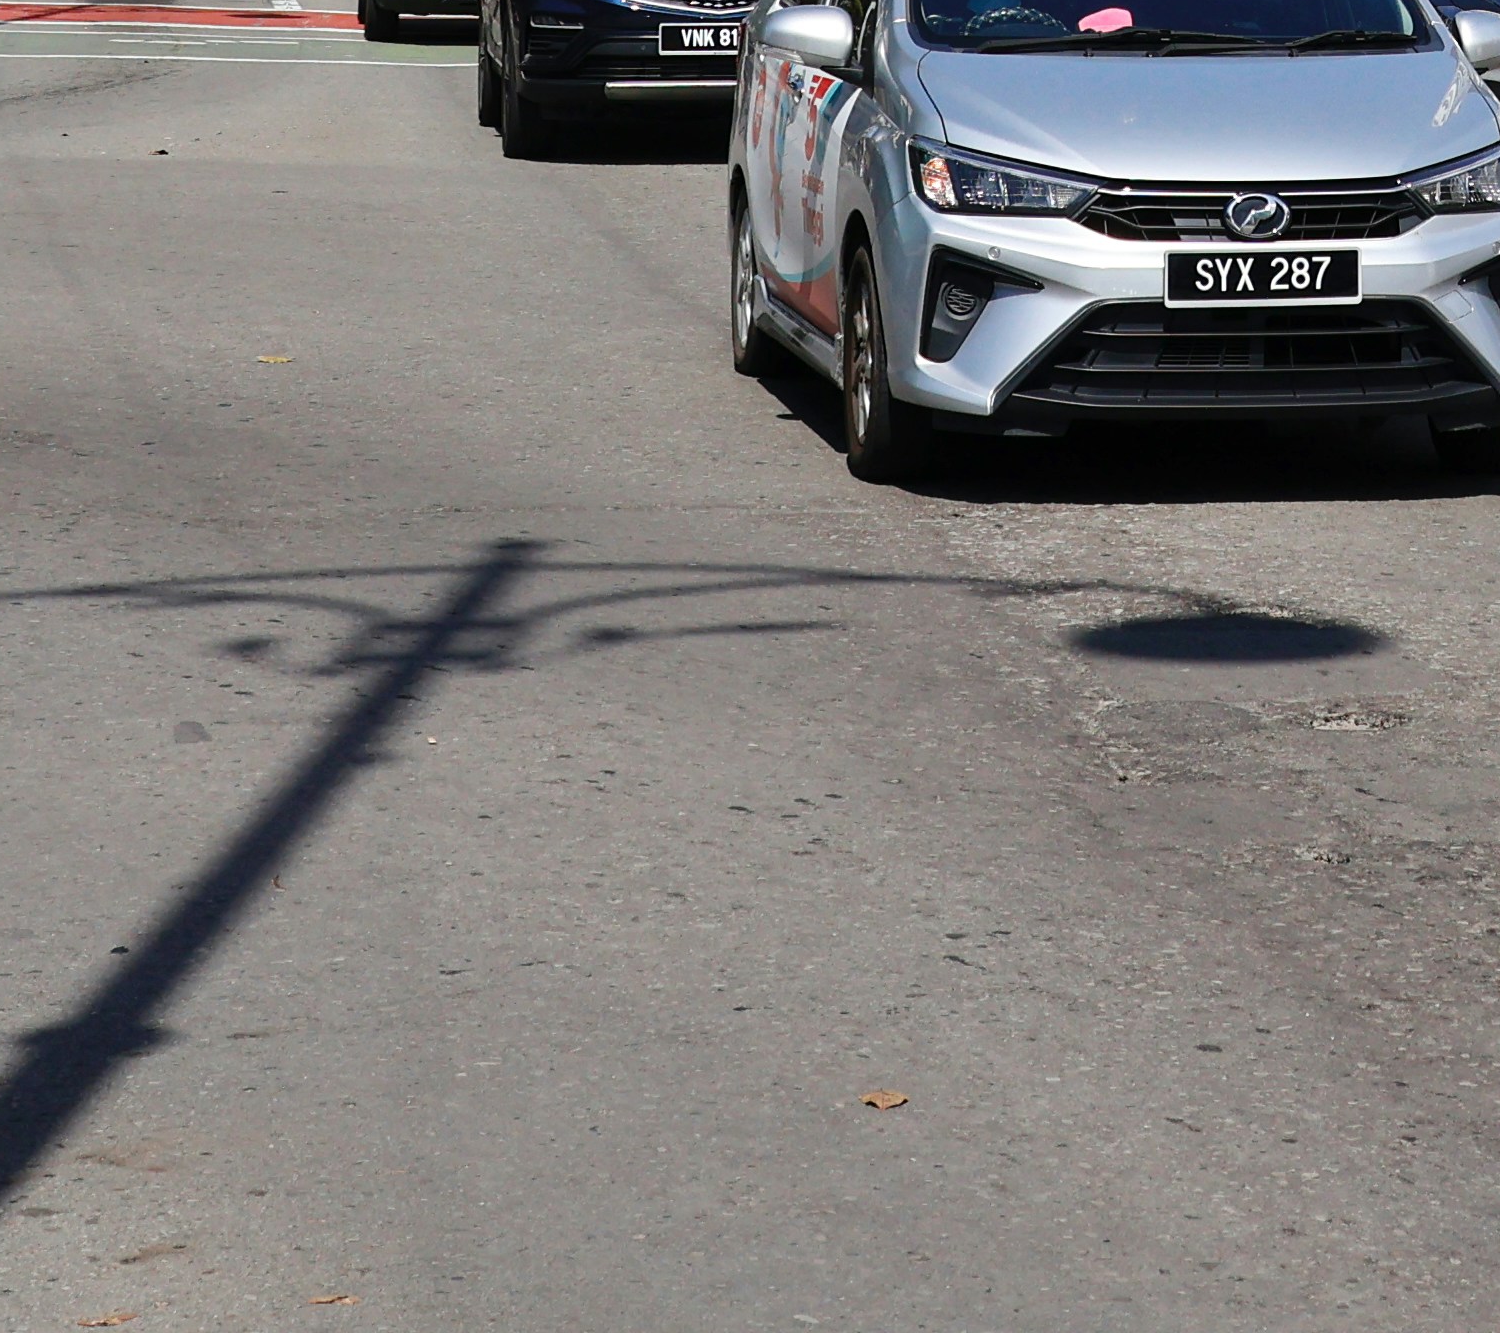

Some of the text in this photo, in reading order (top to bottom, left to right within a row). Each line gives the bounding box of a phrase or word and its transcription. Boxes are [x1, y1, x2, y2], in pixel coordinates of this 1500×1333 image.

[681, 28, 738, 47] VNK 81
[1195, 256, 1332, 292] SYX 287
